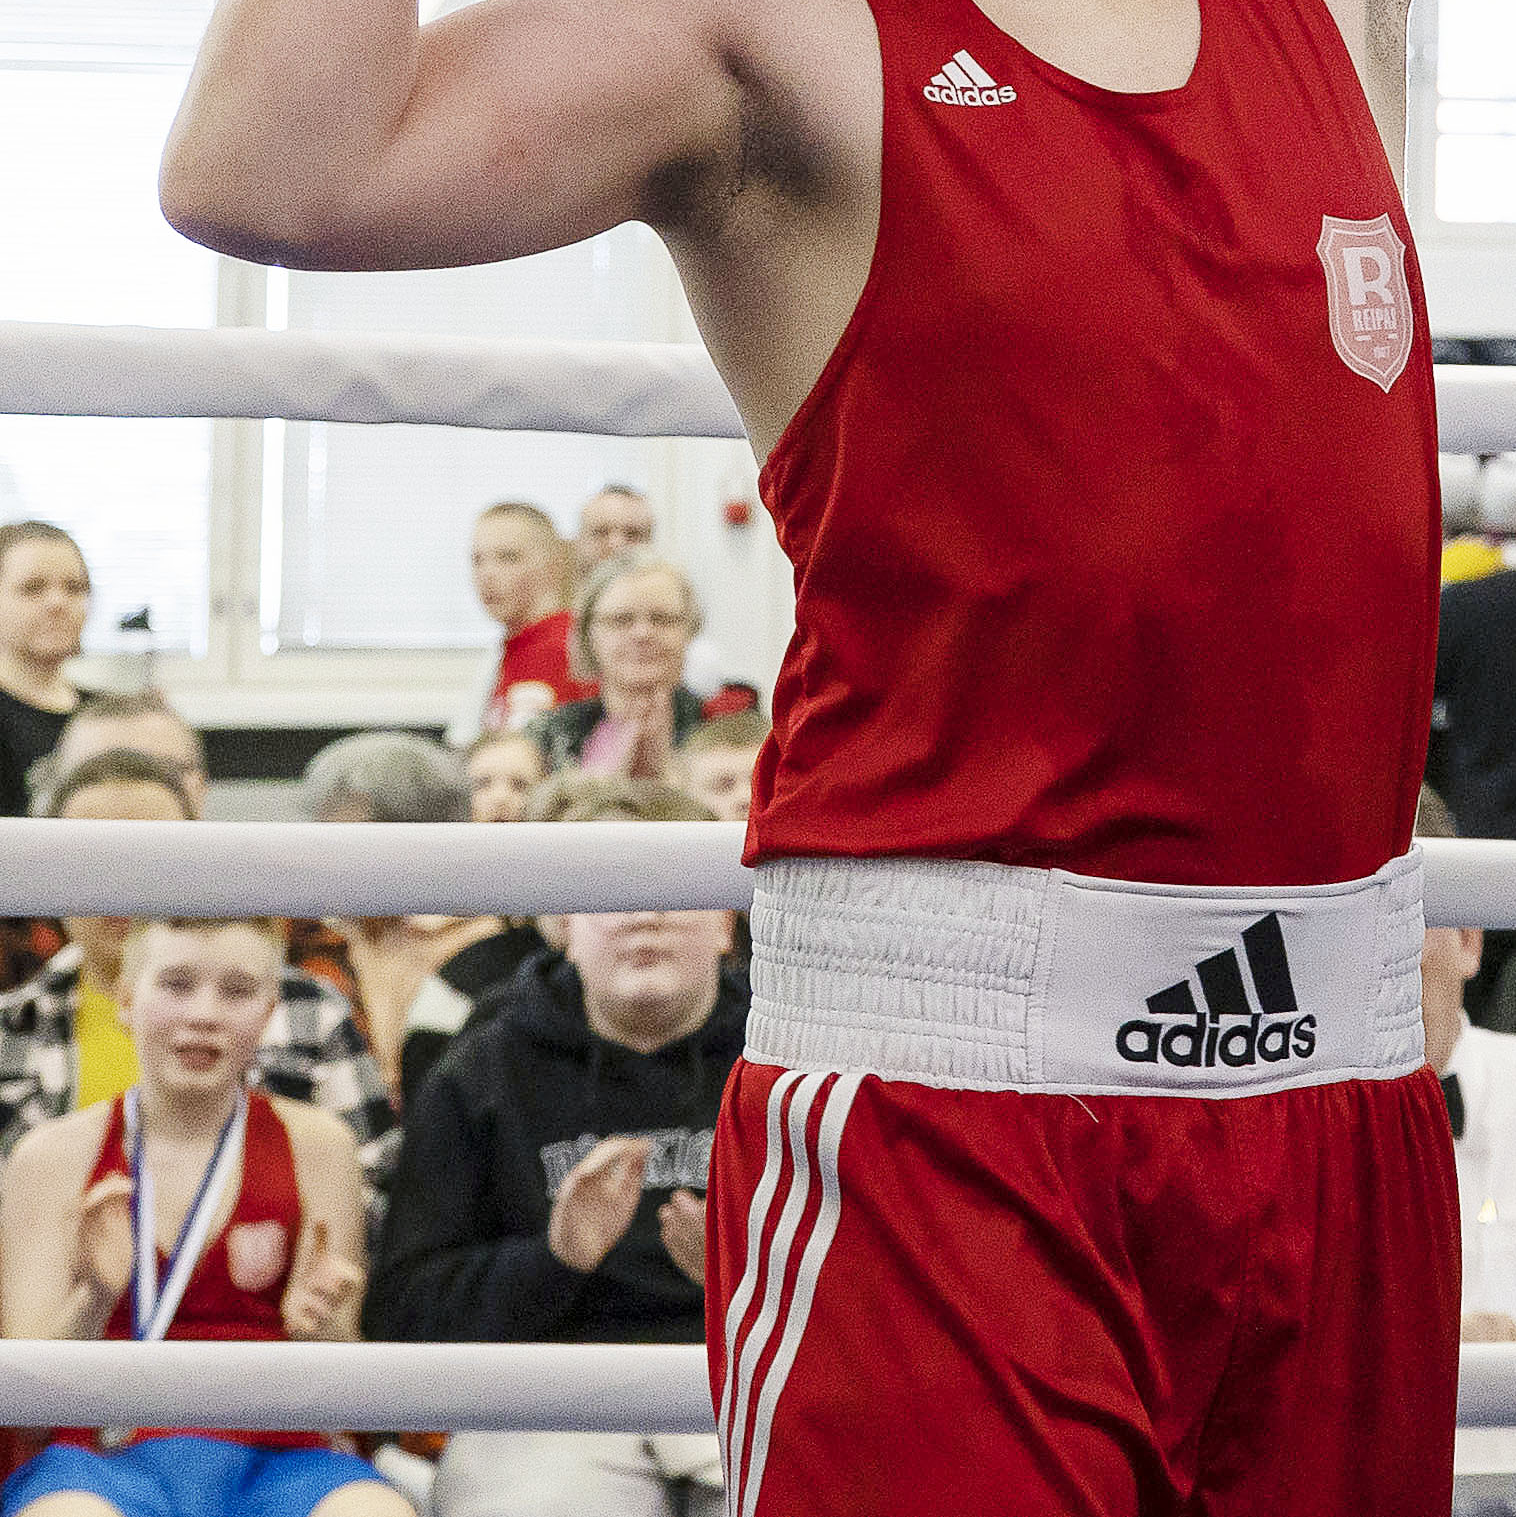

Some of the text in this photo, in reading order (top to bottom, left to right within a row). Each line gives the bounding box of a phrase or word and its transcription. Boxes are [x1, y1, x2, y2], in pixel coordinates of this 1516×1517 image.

[922, 85, 1018, 106] adidas
[1342, 246, 1396, 305] R
[1115, 1012, 1318, 1067] adidas
